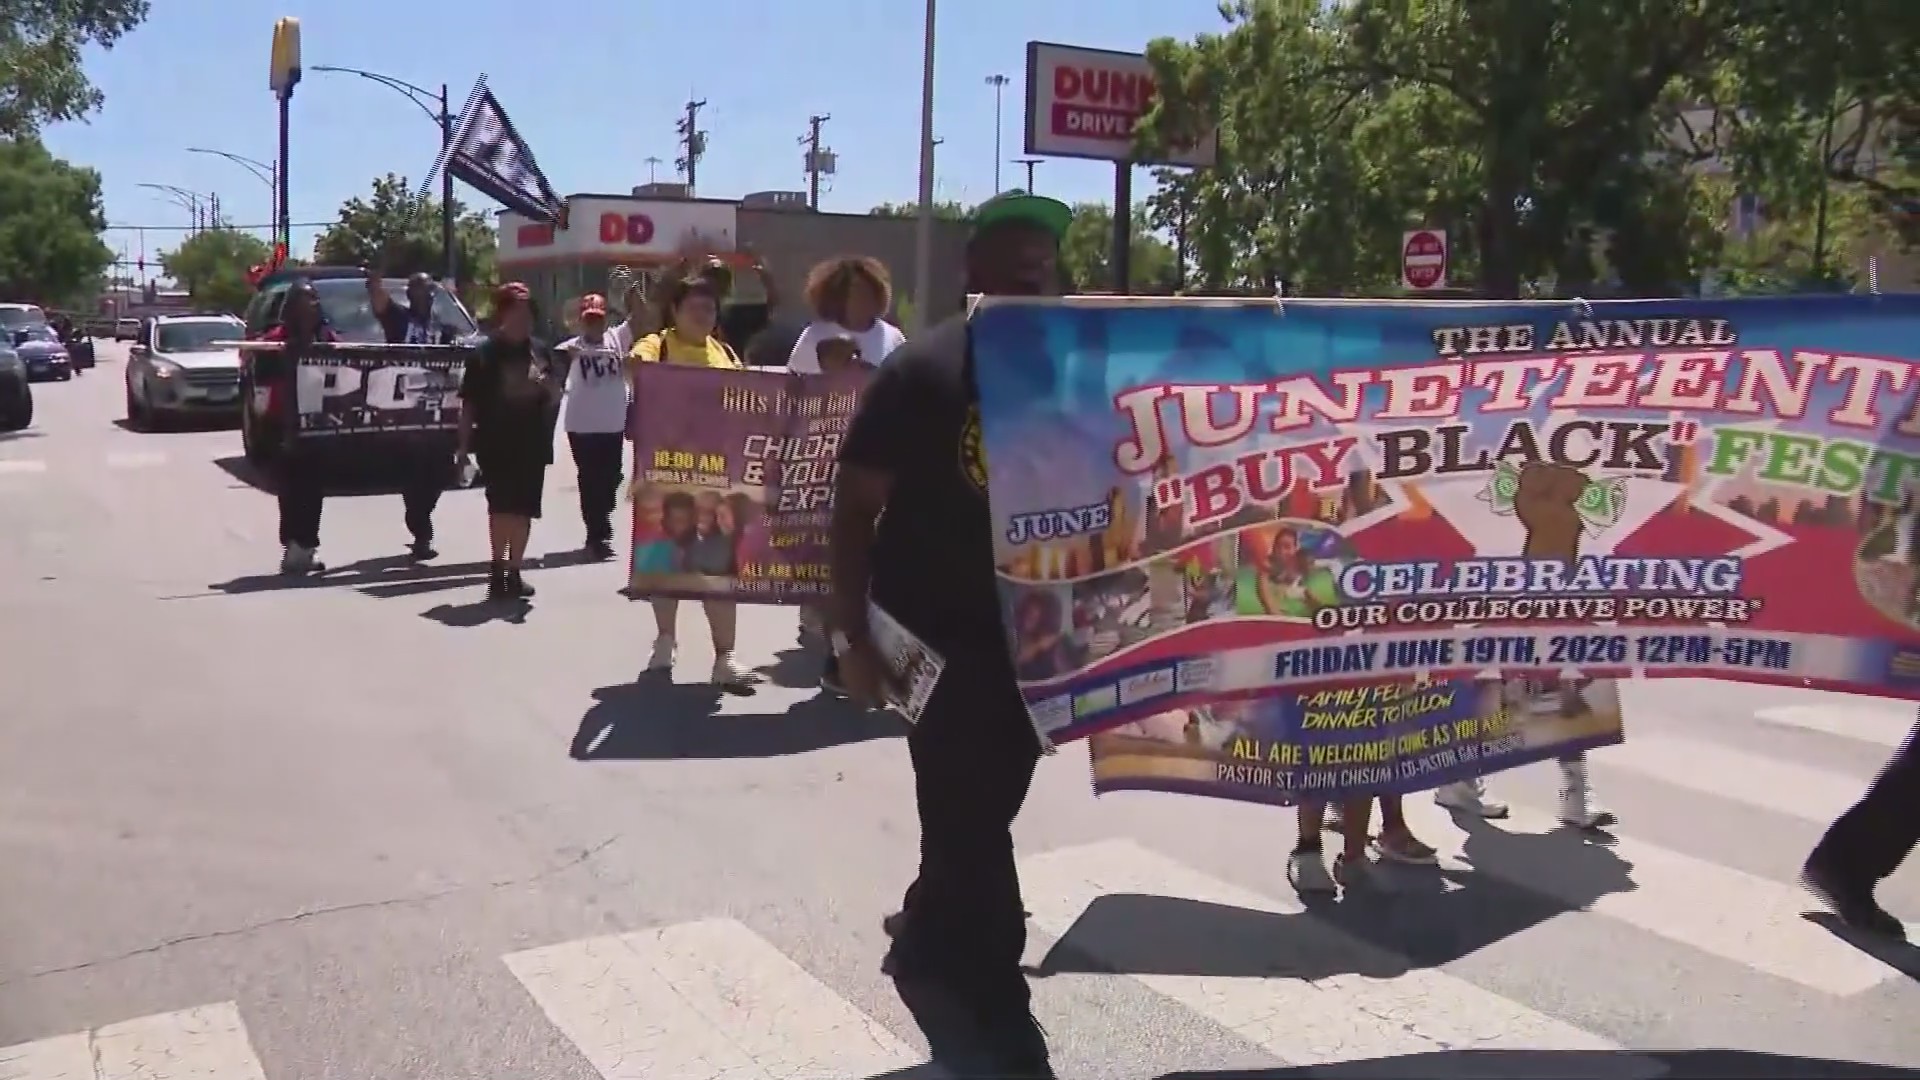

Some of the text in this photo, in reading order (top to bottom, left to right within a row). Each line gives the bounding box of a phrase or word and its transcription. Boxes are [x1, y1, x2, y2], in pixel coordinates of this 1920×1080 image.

[1054, 65, 1158, 107] DUNN
[600, 212, 654, 244] DD
[1433, 318, 1737, 355] THE ANNUAL
[654, 450, 725, 473] 10:00 AM
[743, 434, 848, 460] CHILDR
[778, 486, 836, 511] EXP
[1007, 502, 1112, 546] JUNE
[1341, 557, 1742, 600] CELEBRATING
[1314, 605, 1389, 630] OUR
[1396, 598, 1616, 624] COLLECTIVE
[1275, 635, 1793, 679] FRIDAY JUNE 19TH, 2026 12PM-5PM
[1301, 708, 1377, 730] DINNER
[1232, 736, 1263, 761] ALL
[1269, 742, 1302, 766] ARE
[1433, 722, 1451, 747] AS
[1453, 718, 1479, 740] YOU
[1217, 763, 1272, 788] PASTOR
[1276, 770, 1297, 790] ST.
[1300, 771, 1337, 789] JOHN
[1341, 766, 1391, 787] CHISUM
